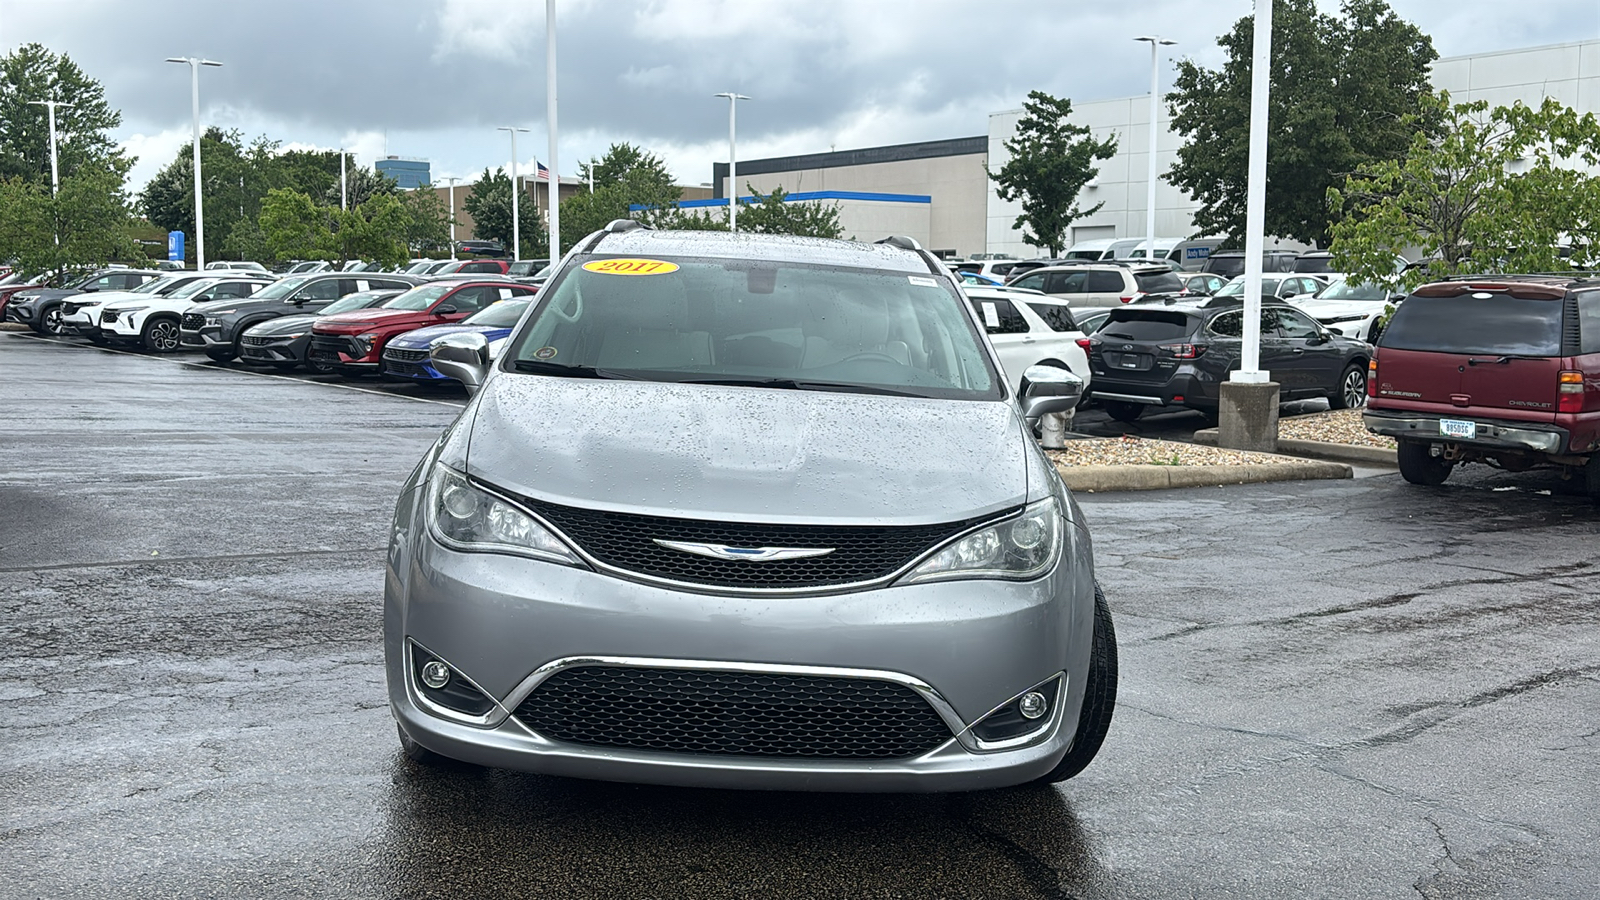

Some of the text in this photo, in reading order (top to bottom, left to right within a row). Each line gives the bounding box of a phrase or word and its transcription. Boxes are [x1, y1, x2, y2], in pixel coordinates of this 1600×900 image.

[597, 262, 664, 272] 2017
[1387, 390, 1422, 398] SUBURBAN
[1508, 399, 1552, 408] CHEVROLET
